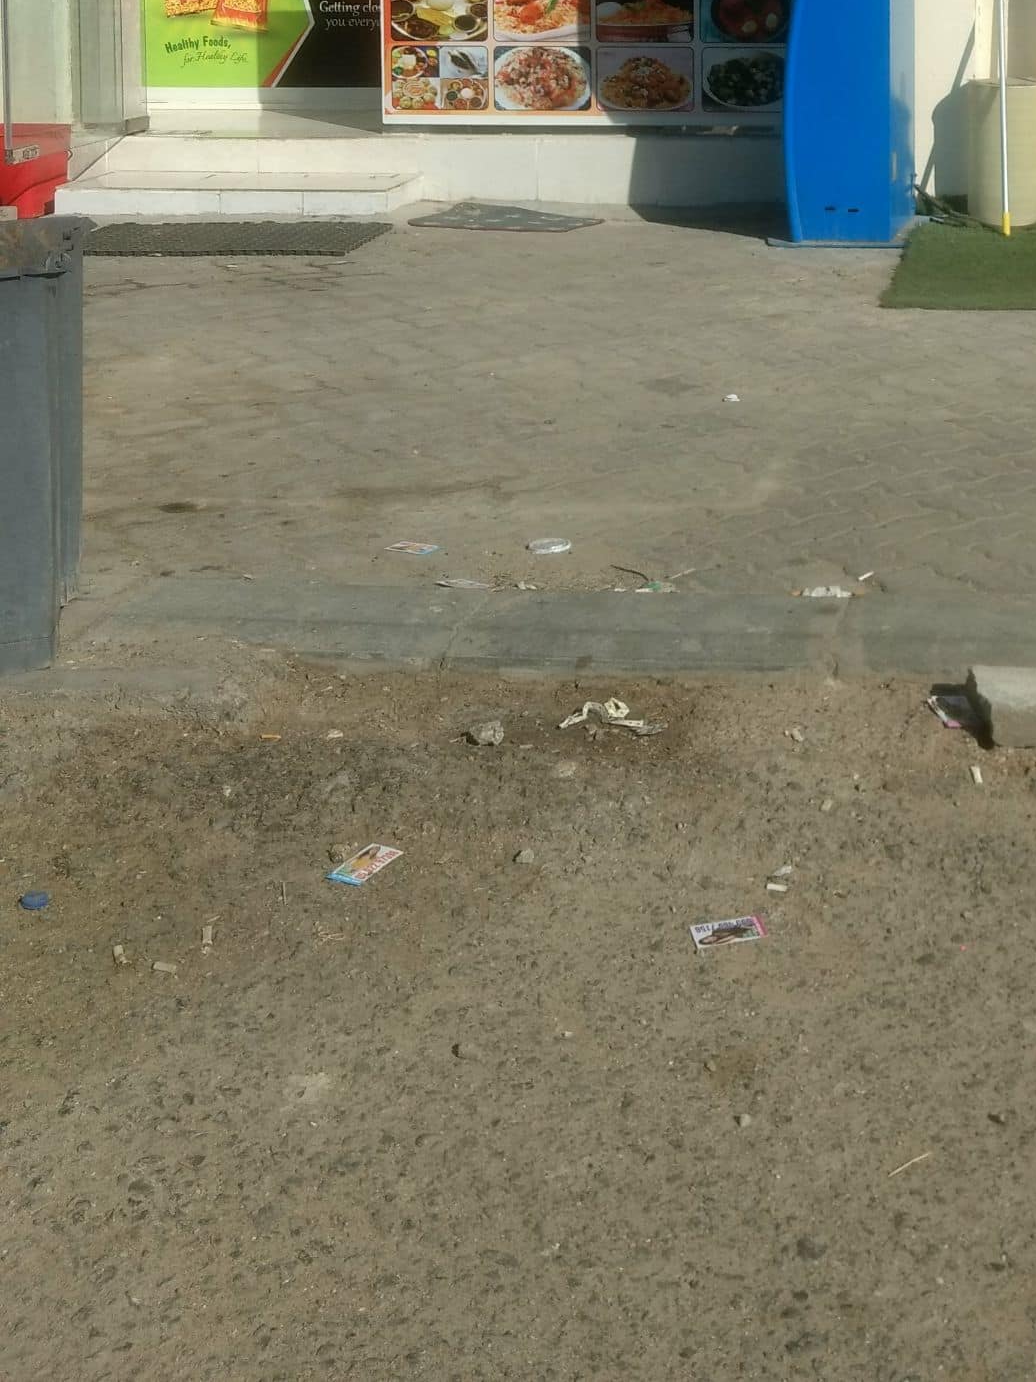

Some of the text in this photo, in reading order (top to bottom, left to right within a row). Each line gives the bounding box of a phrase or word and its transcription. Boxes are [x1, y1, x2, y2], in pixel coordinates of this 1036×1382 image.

[319, 0, 360, 16] Getting
[326, 18, 346, 31] you
[165, 37, 199, 54] Healthy
